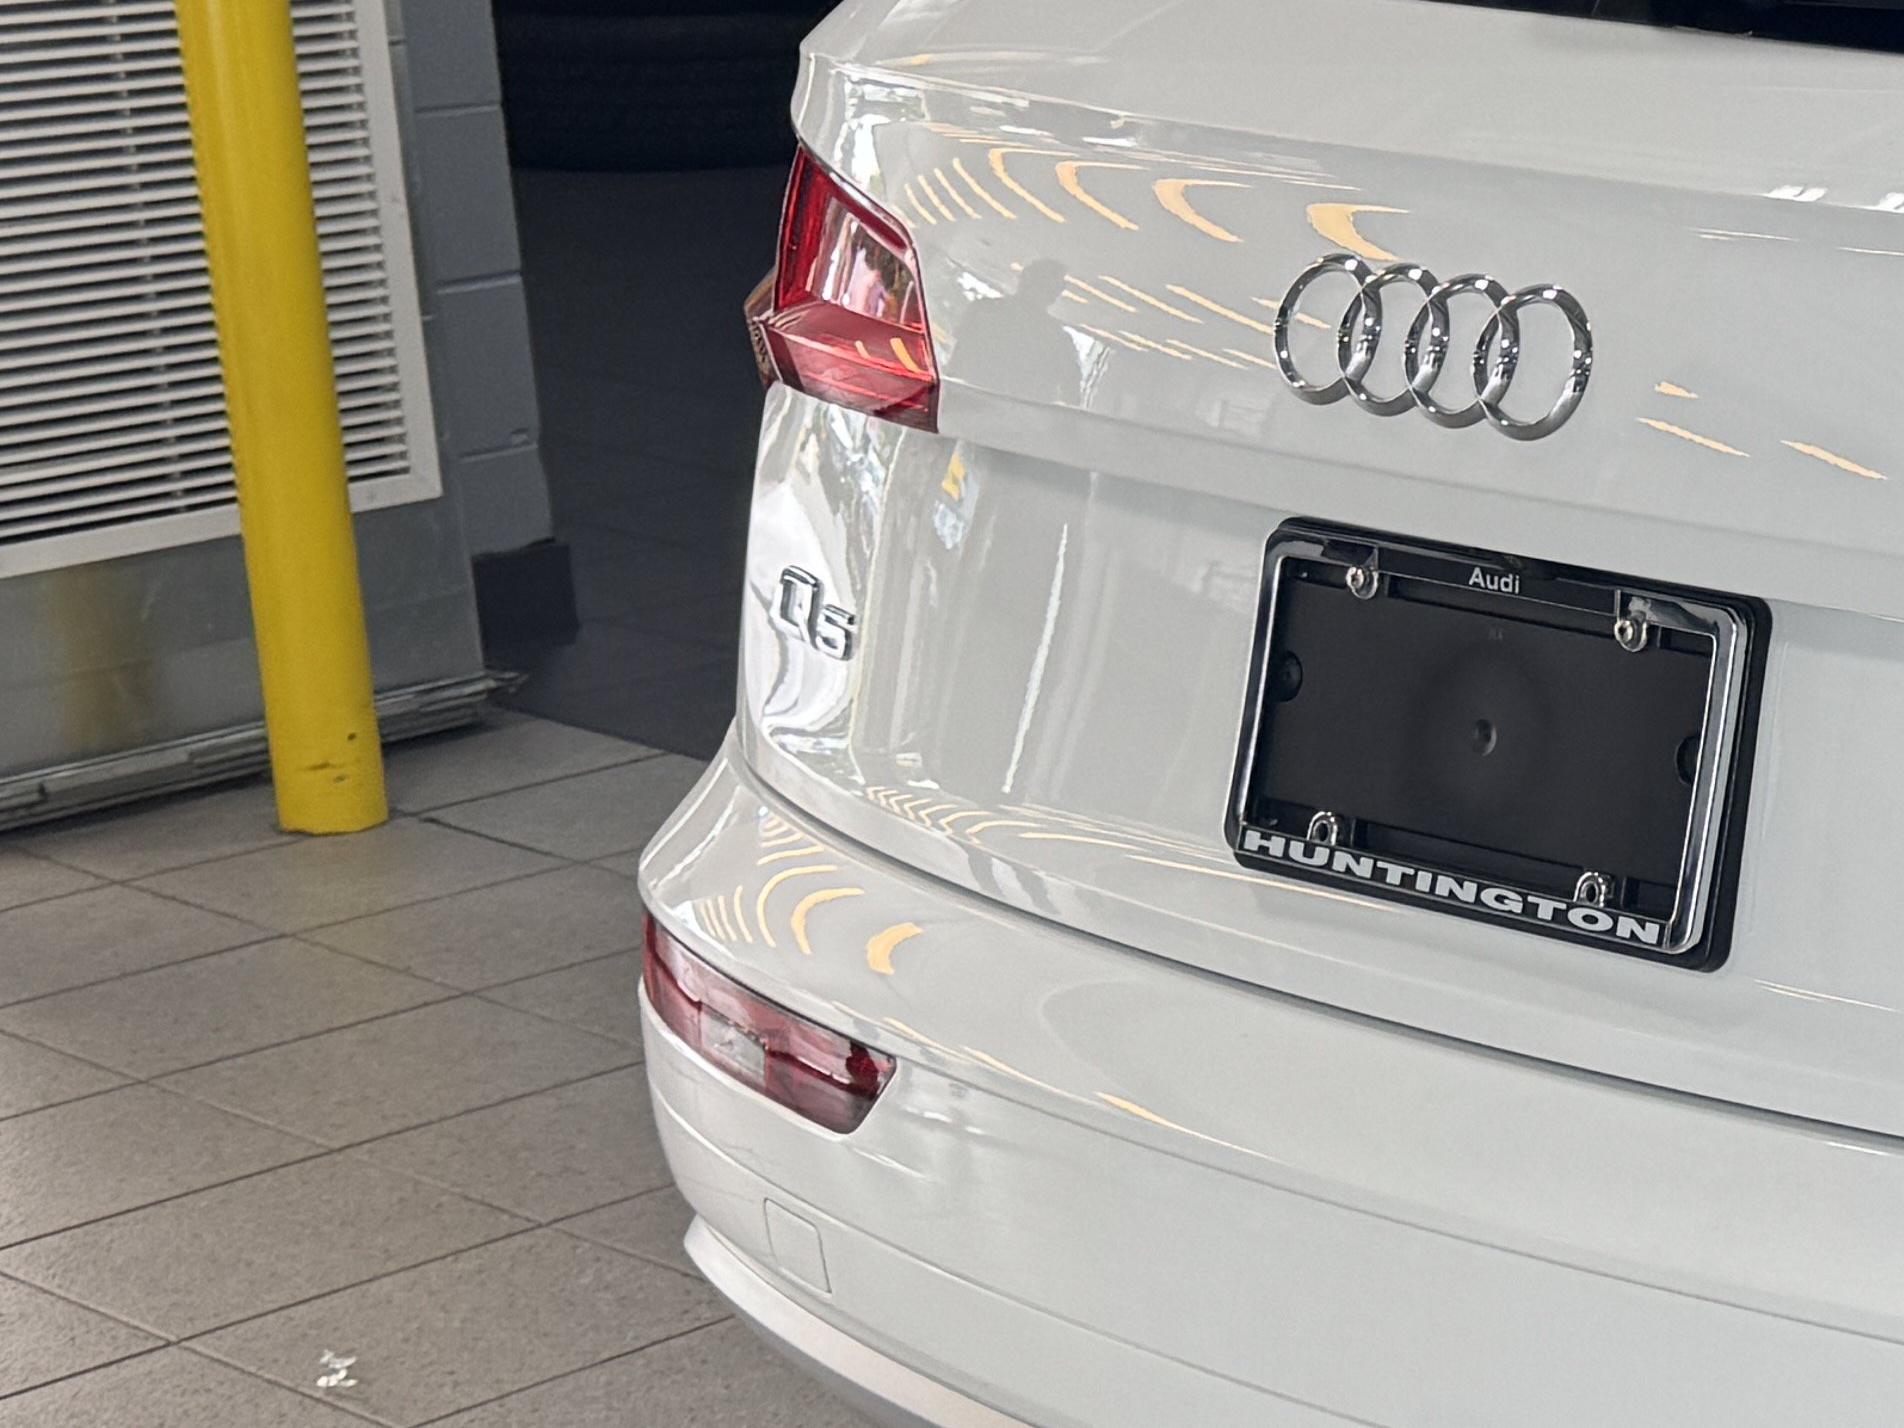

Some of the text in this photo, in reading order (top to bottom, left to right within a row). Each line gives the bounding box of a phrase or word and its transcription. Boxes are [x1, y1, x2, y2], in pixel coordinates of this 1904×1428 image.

[769, 565, 858, 662] Q5
[1468, 566, 1521, 595] Audi
[1243, 829, 1660, 945] HUNTINGTON
